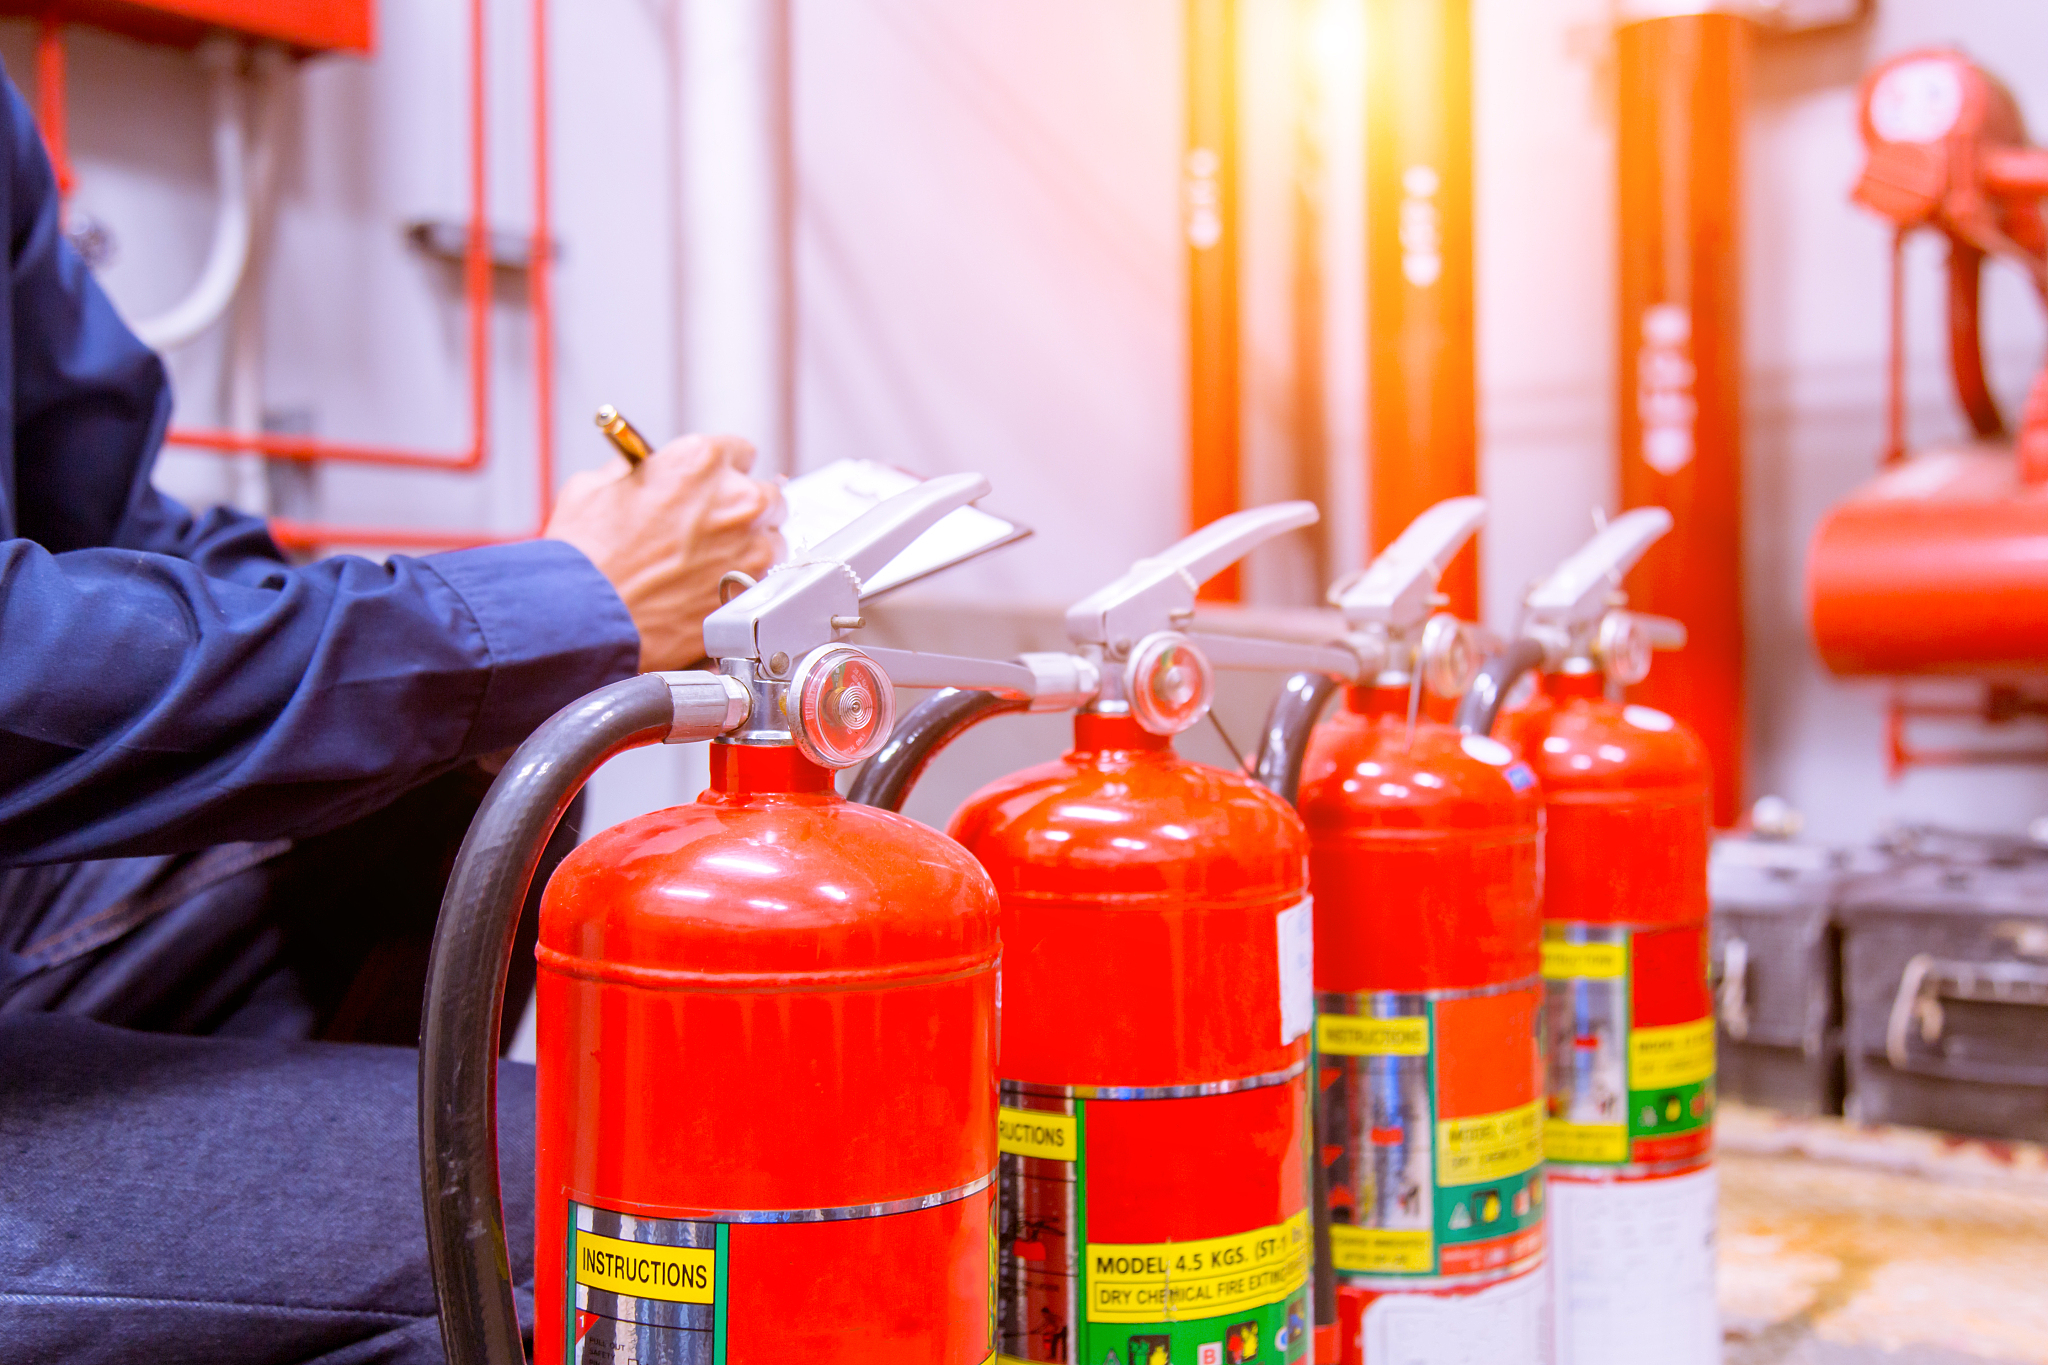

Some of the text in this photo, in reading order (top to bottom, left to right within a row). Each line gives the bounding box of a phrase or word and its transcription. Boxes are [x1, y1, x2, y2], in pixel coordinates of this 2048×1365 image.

[582, 1246, 708, 1290] INSTRUCTIONS
[1096, 1256, 1166, 1275] MODEL
[1175, 1252, 1203, 1273] 4.5
[1211, 1246, 1249, 1268] KGS.
[1100, 1289, 1132, 1305] DRY
[1136, 1284, 1212, 1305] CHEMICAL
[1217, 1277, 1245, 1298] FIRE
[578, 1314, 585, 1328] 1
[589, 1336, 626, 1351] PULL OUT
[589, 1347, 616, 1360] SAFETY
[1203, 1348, 1217, 1365] B
